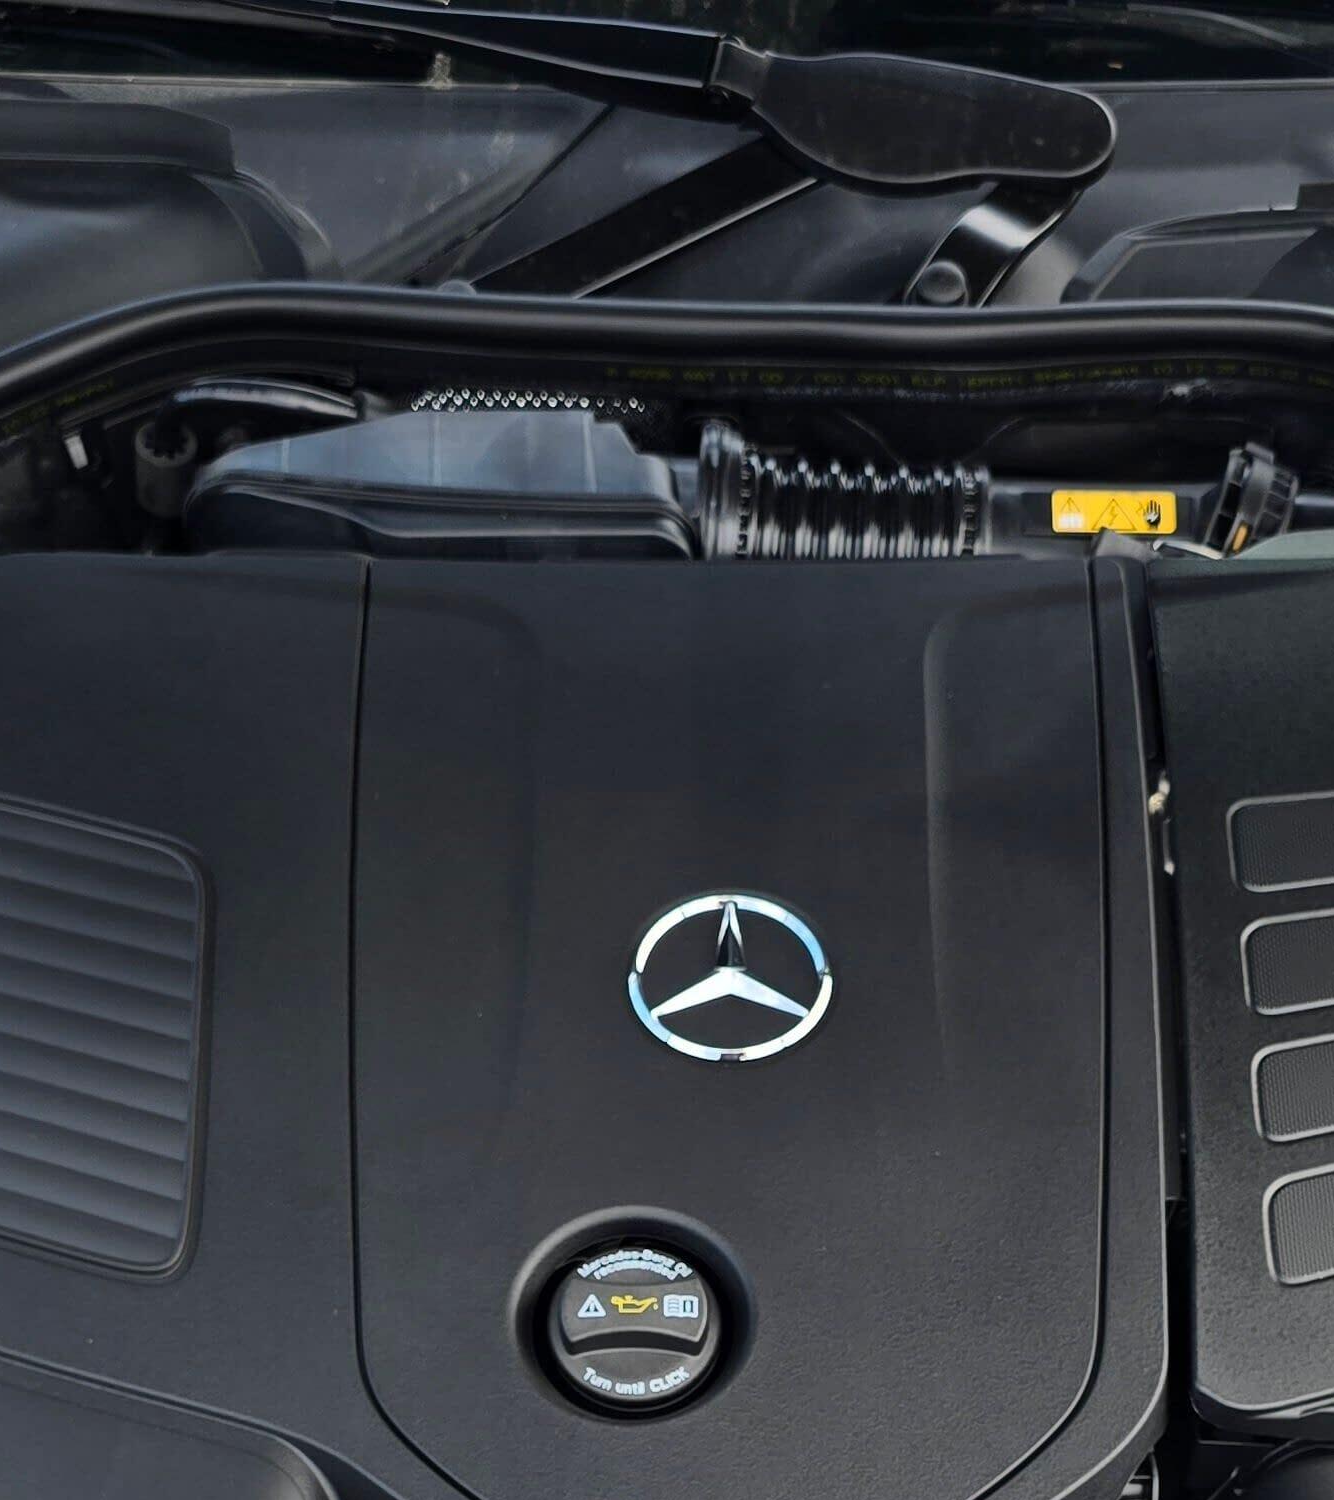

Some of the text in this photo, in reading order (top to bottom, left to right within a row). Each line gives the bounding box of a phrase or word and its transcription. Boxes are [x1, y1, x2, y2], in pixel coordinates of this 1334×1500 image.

[576, 1249, 676, 1279] Mercedes-Benz
[593, 1259, 679, 1281] recommended
[583, 1366, 690, 1395] Turn until CLICK
